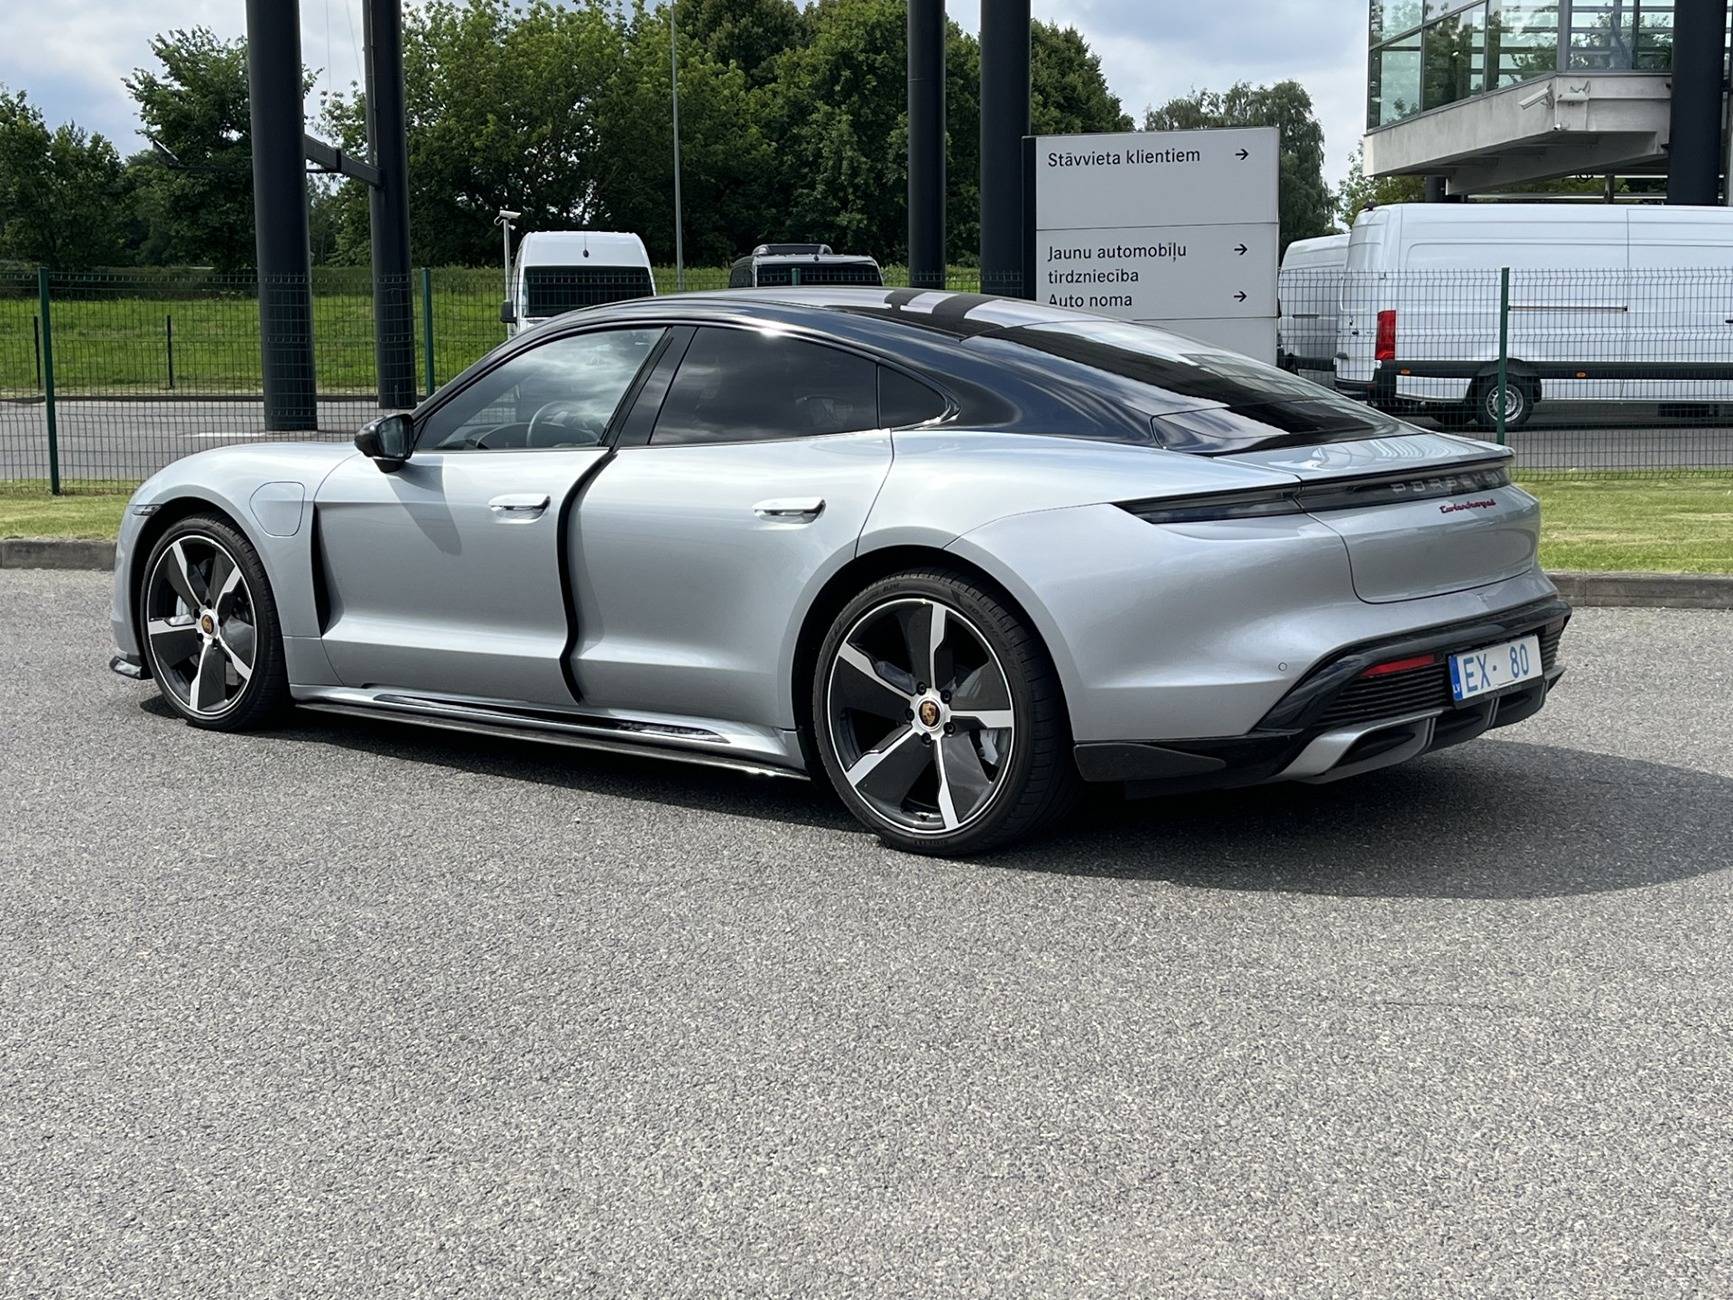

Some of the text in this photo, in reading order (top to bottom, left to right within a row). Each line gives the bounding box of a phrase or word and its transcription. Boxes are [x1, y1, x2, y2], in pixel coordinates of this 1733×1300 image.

[1047, 148, 1200, 167] Stāvvieta klientiem
[1047, 242, 1187, 262] Jaunu automobiļu
[1048, 268, 1139, 284] tirdzniecība
[1049, 293, 1133, 307] Auto noma
[1509, 643, 1530, 679] 80
